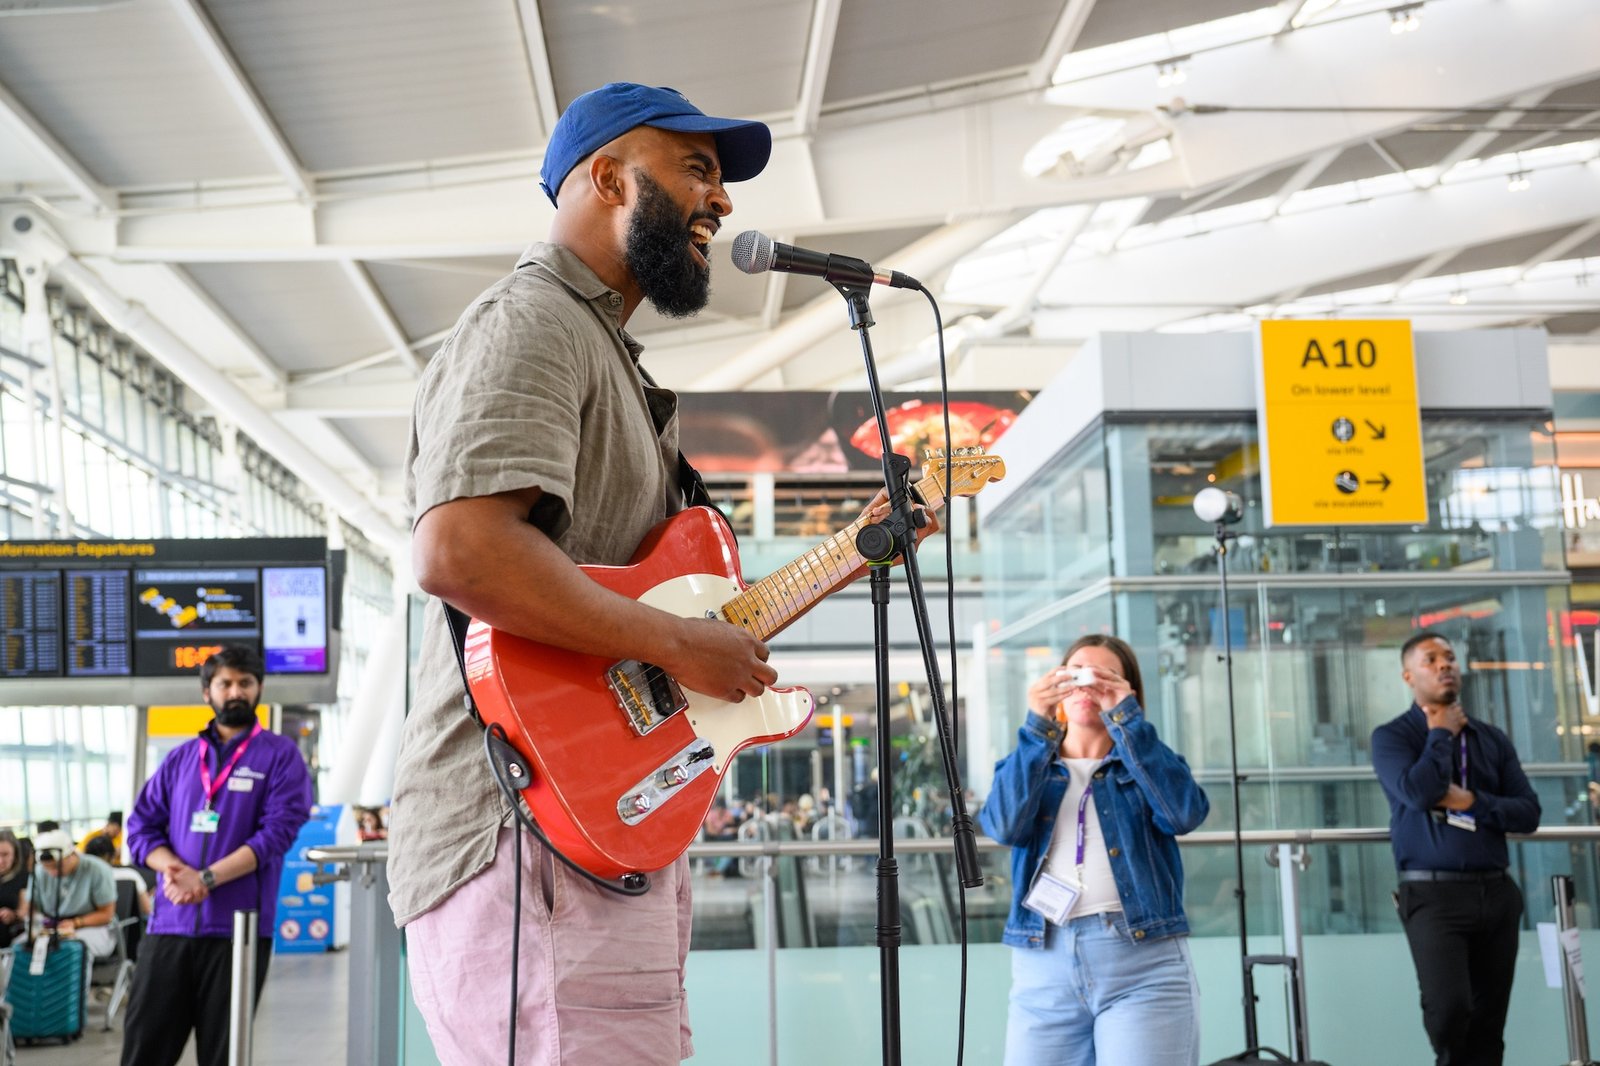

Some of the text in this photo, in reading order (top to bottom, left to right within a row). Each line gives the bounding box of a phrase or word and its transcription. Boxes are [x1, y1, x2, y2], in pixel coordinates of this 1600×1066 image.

[1301, 338, 1377, 369] A10
[1291, 382, 1391, 397] On lower level
[77, 542, 156, 559] Departures
